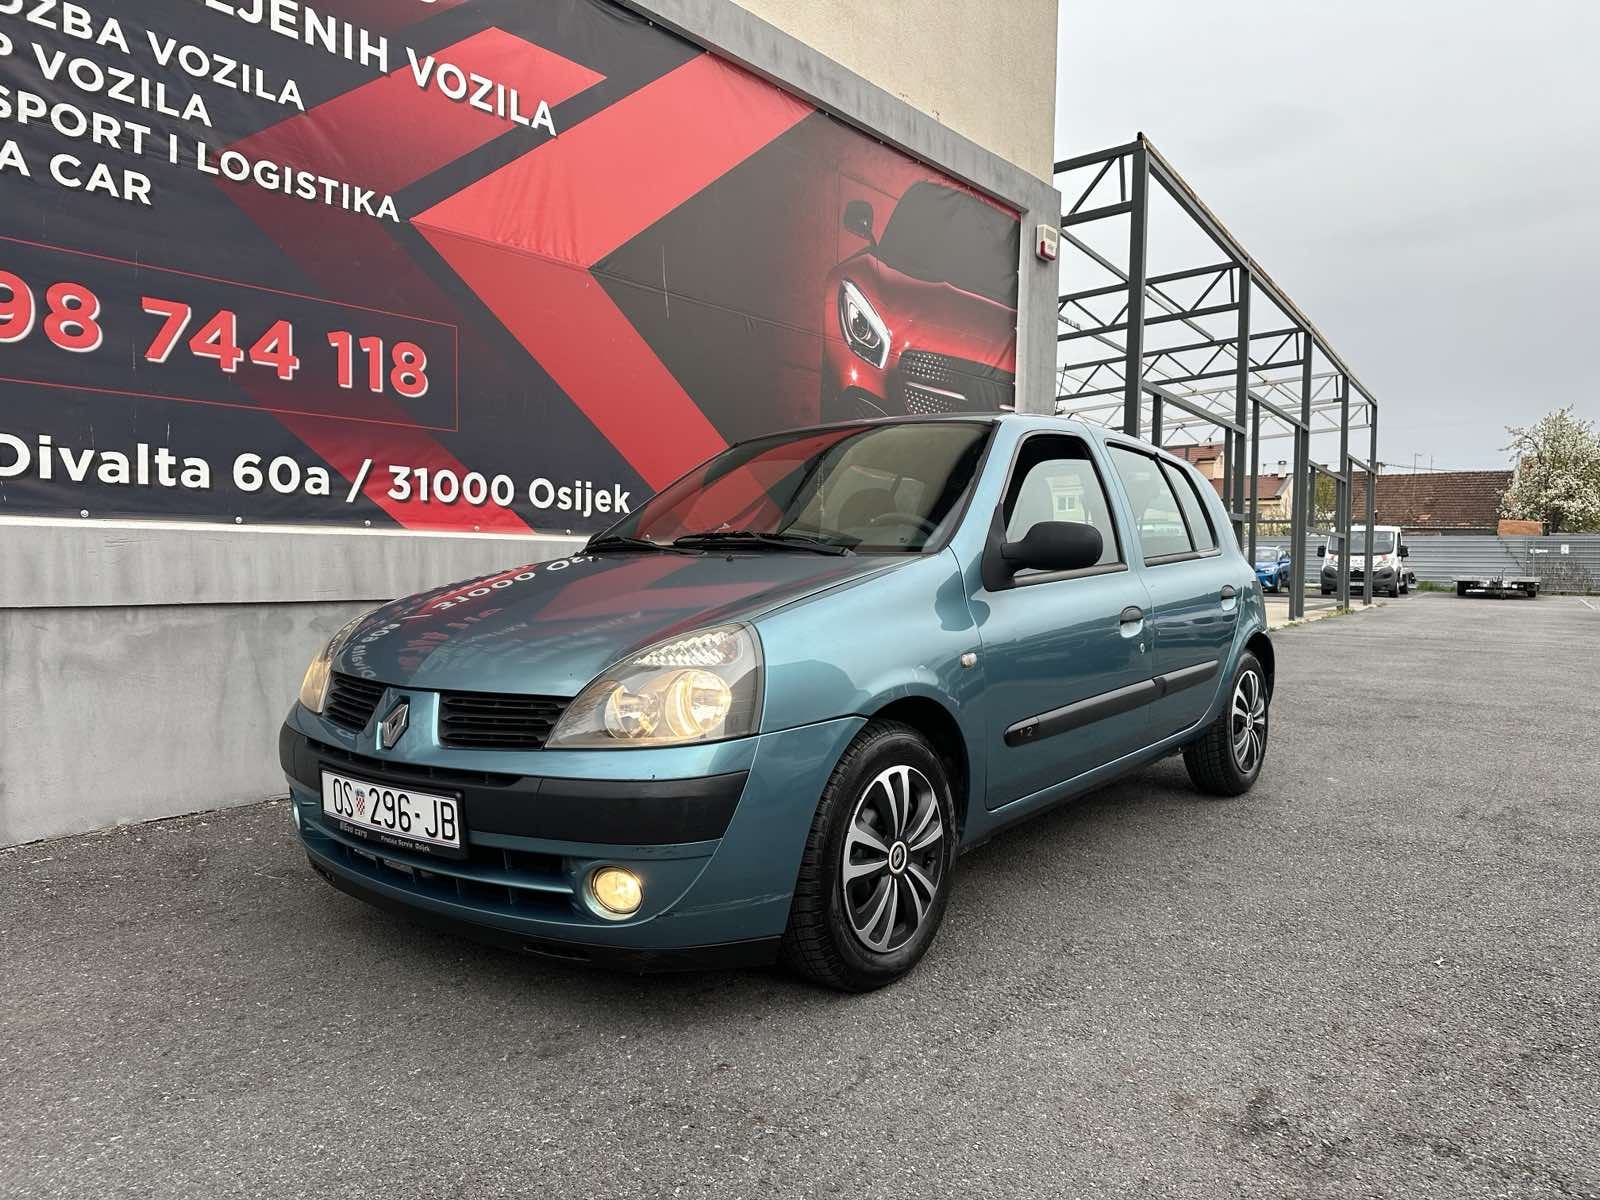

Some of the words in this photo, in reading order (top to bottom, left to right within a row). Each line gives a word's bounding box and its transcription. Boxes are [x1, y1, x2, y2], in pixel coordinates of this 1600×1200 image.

[32, 42, 213, 128] VOZILA
[146, 30, 305, 112] VOZILA
[406, 46, 557, 137] VOZILA
[0, 140, 31, 177] A
[50, 153, 152, 206] CAR
[169, 133, 178, 164] I
[198, 142, 401, 223] LOGISTIKA
[138, 296, 301, 381] 744
[328, 331, 430, 399] 118
[0, 434, 210, 489] Divalta
[233, 452, 331, 497] 60a
[346, 458, 373, 503] /
[388, 465, 515, 509] 31000
[529, 477, 631, 518] Osijek
[333, 778, 354, 818] OS
[368, 787, 456, 841] 296-JB
